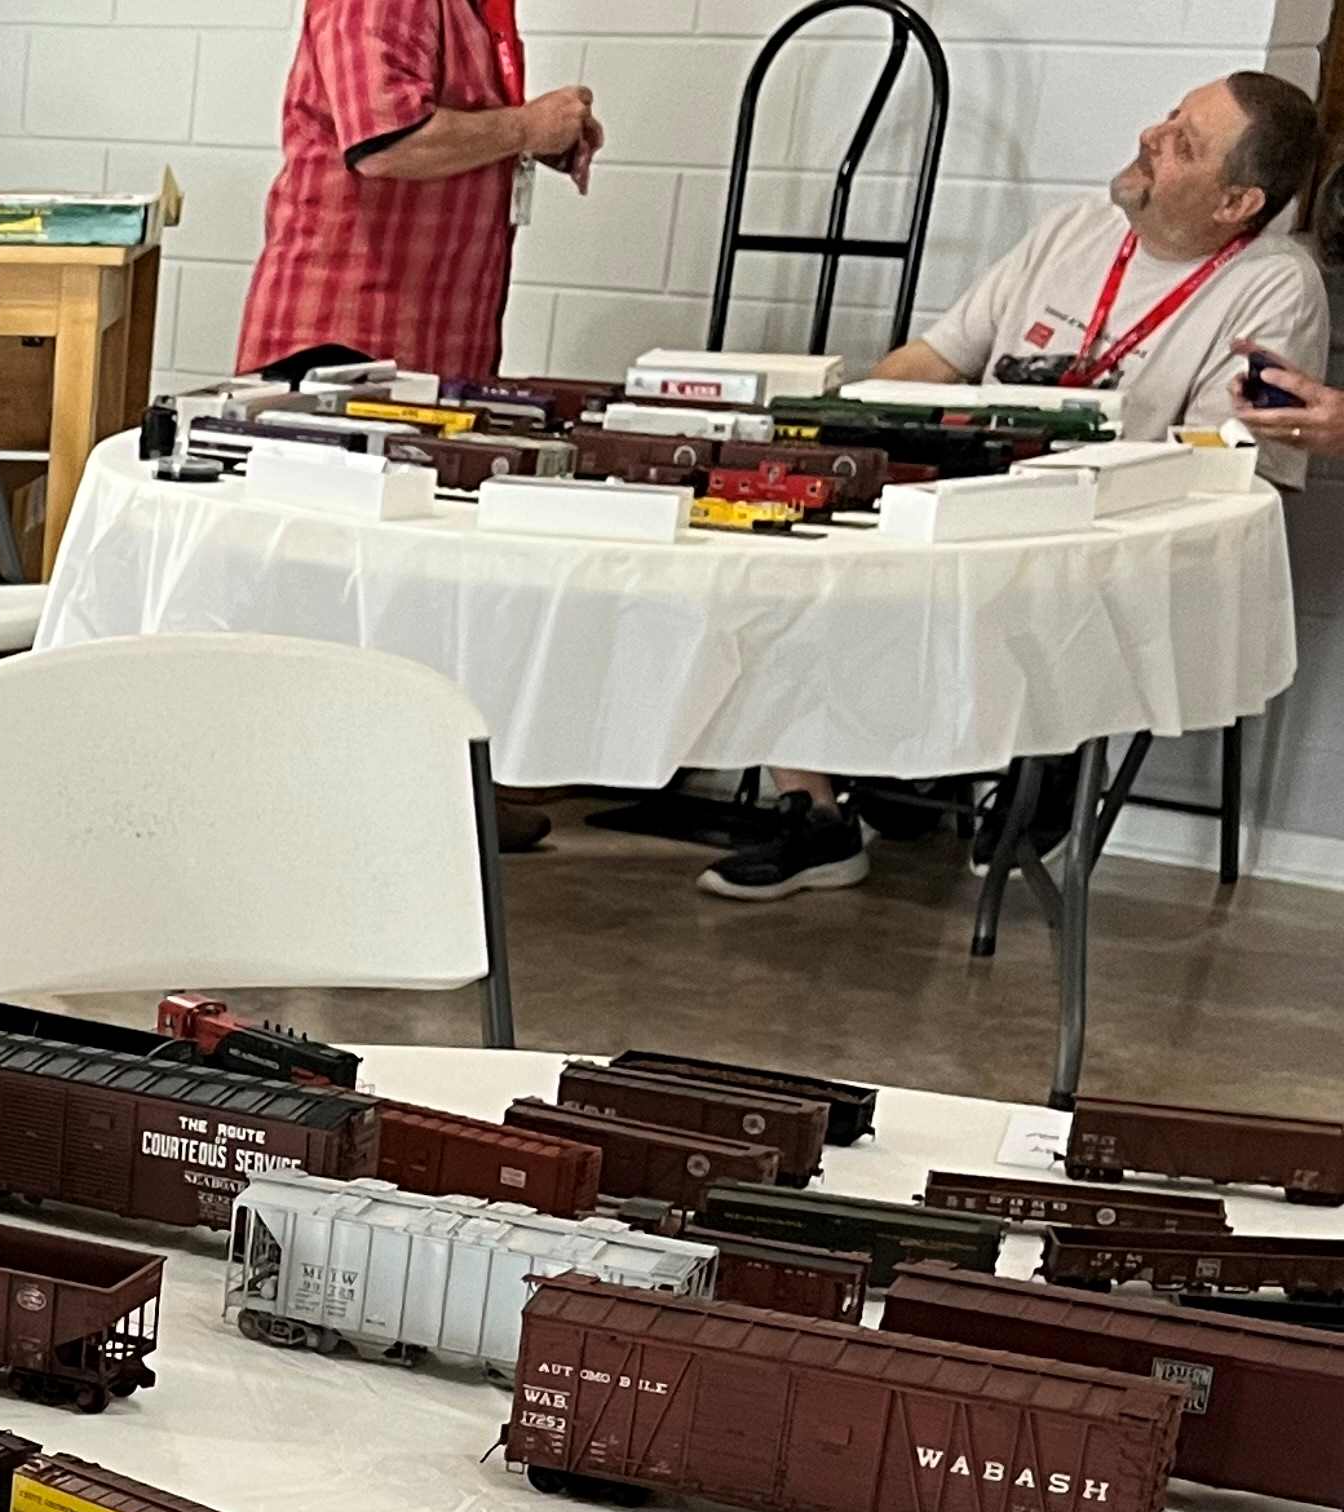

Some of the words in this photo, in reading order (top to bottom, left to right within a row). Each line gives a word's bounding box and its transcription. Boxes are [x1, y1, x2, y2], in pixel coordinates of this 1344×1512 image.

[178, 1115, 209, 1134] THE
[217, 1123, 266, 1145] ROUTE
[142, 1131, 227, 1169] COURTEOUS
[916, 1446, 1110, 1502] WABASH
